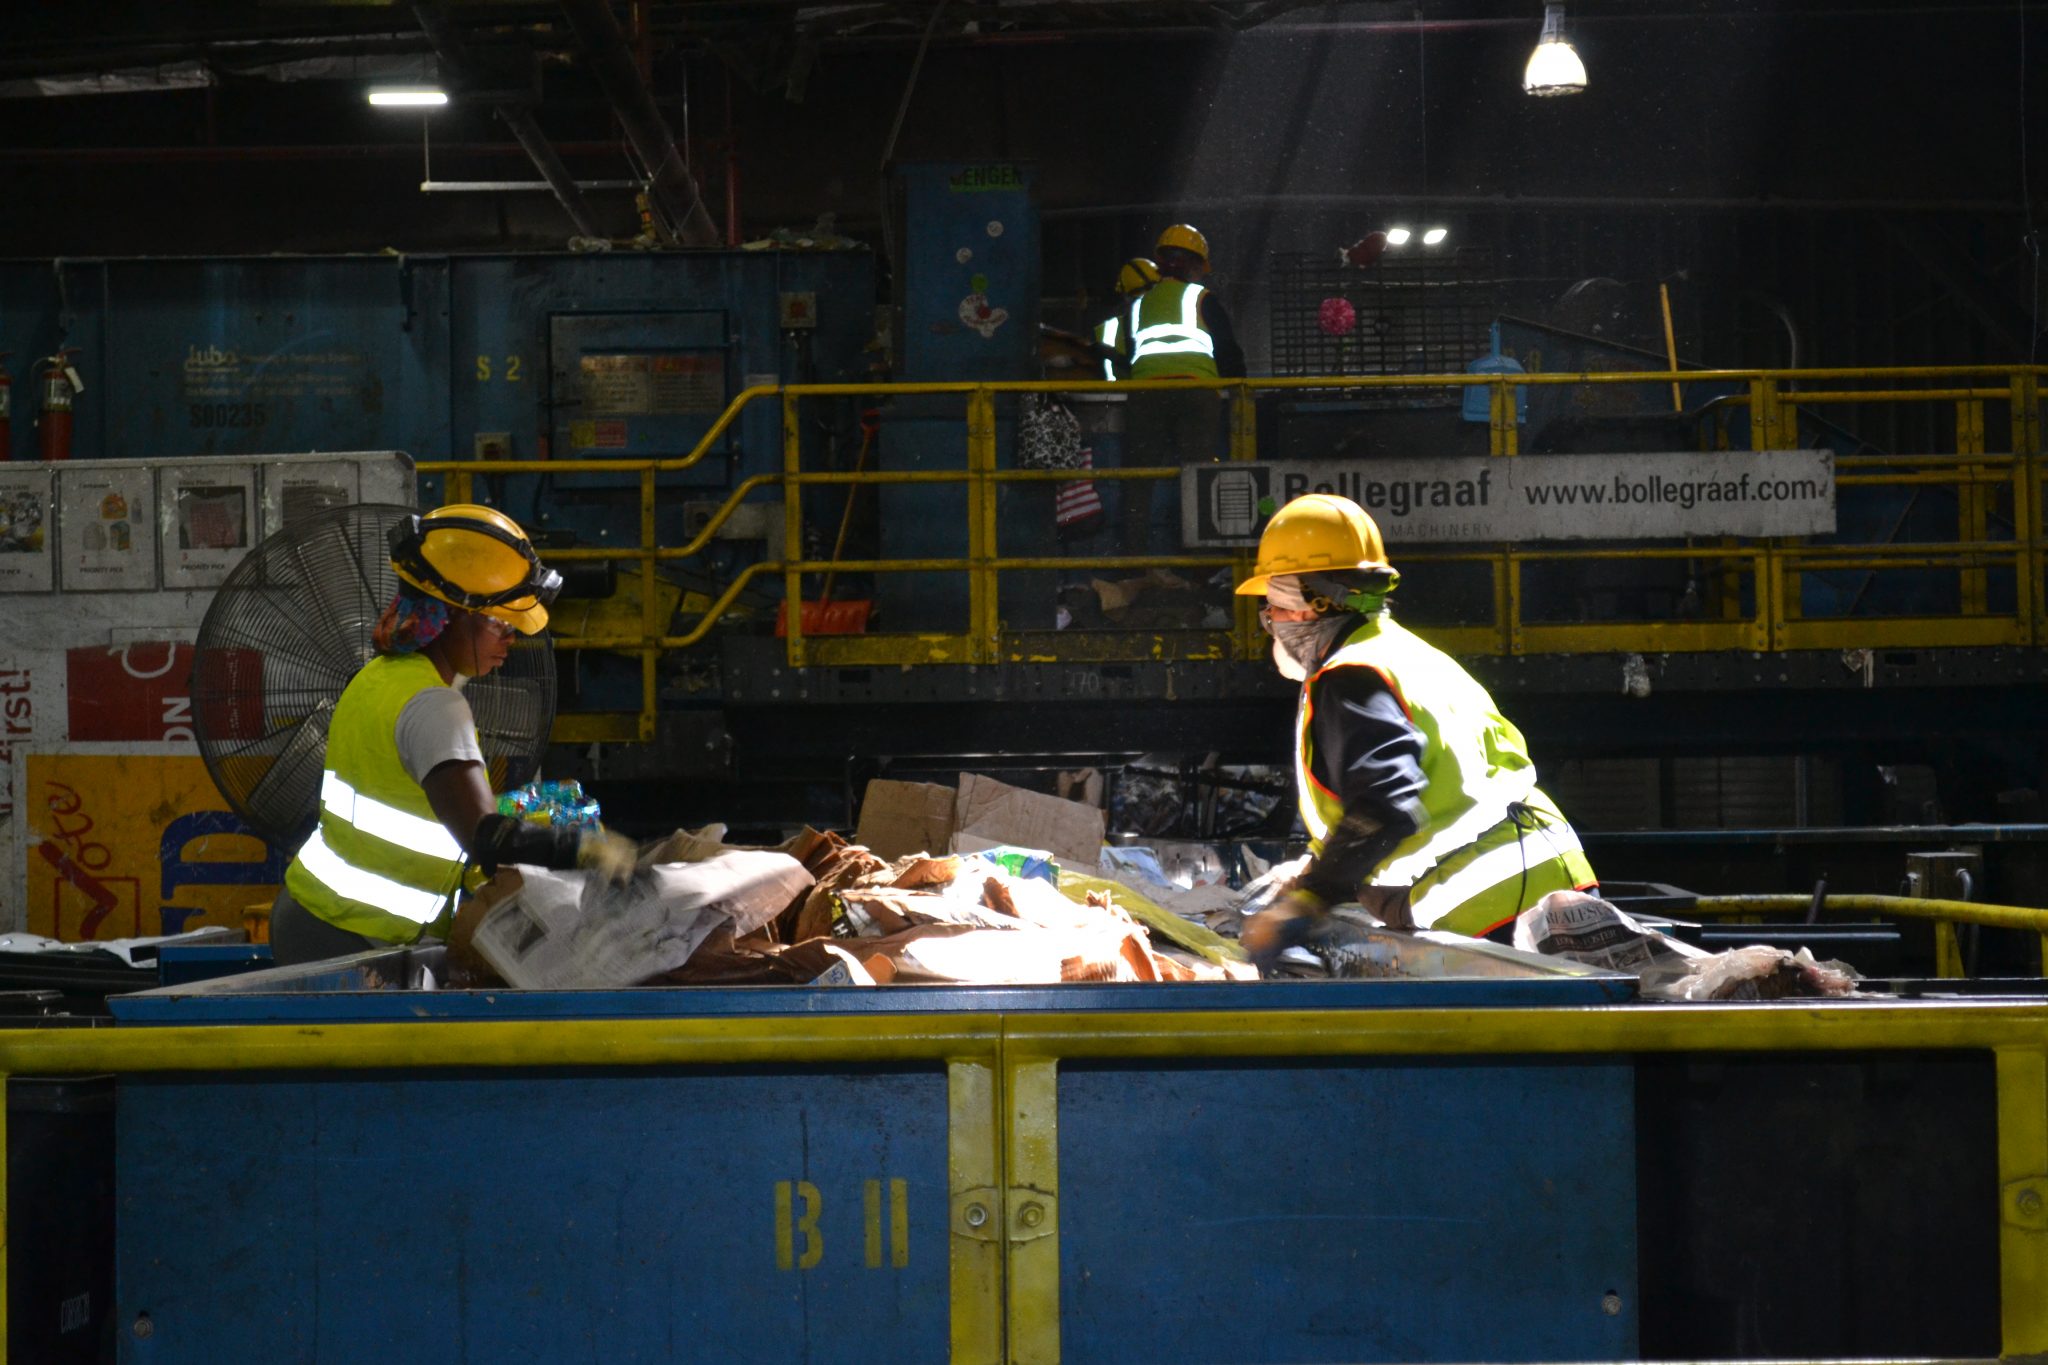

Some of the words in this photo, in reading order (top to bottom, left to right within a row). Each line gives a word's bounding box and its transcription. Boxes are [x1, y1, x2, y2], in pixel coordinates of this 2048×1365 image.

[477, 355, 491, 381] S
[506, 355, 521, 381] 2
[1525, 473, 1817, 510] www.bollegraaf.com
[1389, 522, 1494, 539] MACHINERY
[775, 1178, 824, 1270] B
